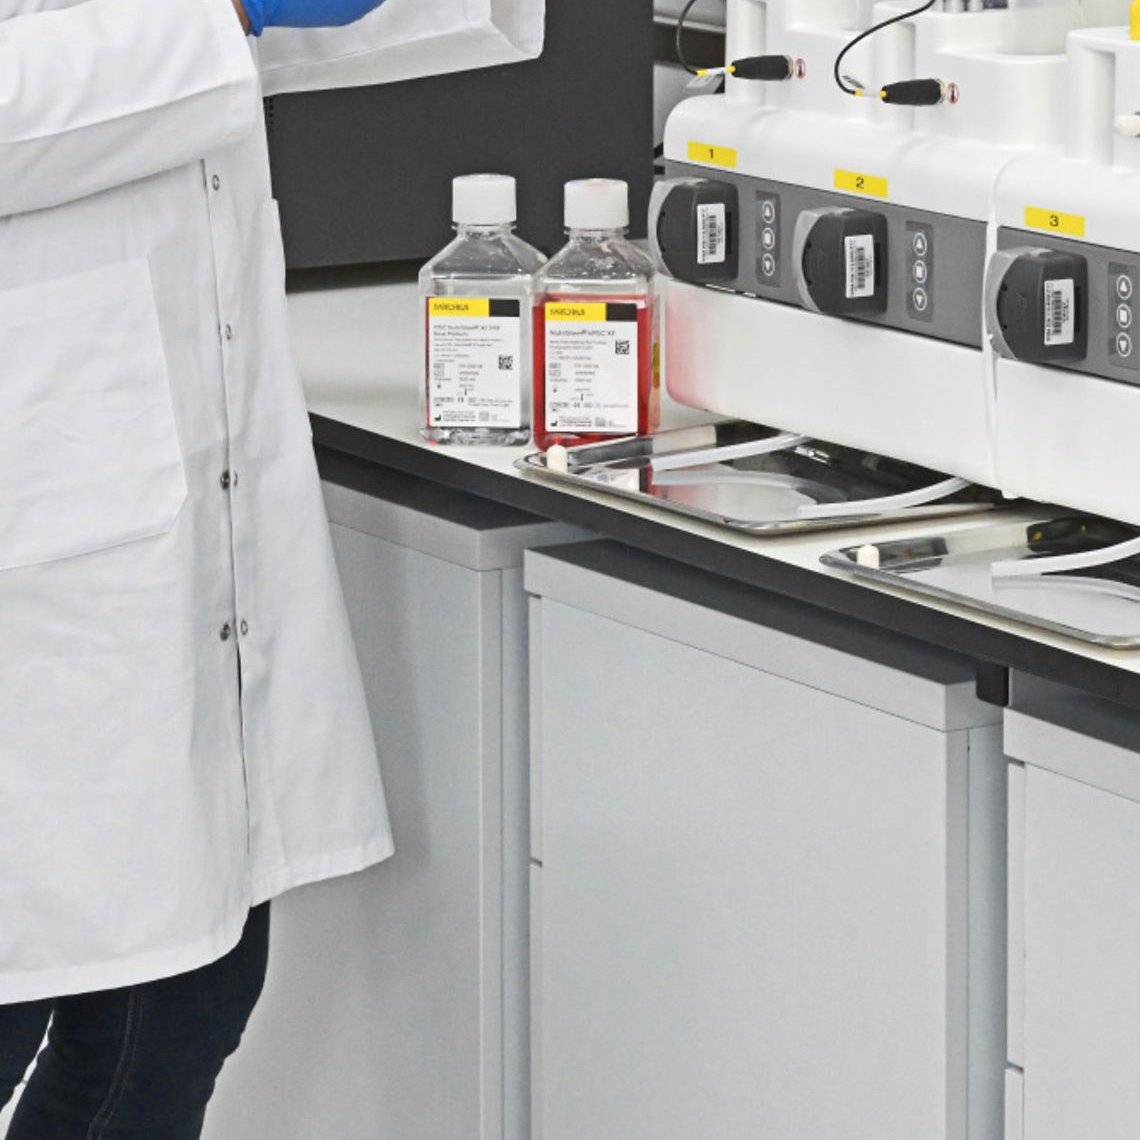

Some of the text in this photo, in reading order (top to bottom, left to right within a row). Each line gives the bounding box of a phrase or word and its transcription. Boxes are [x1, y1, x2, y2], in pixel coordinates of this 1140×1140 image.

[708, 148, 715, 159] 1
[855, 176, 865, 190] 2
[1049, 214, 1060, 228] 3
